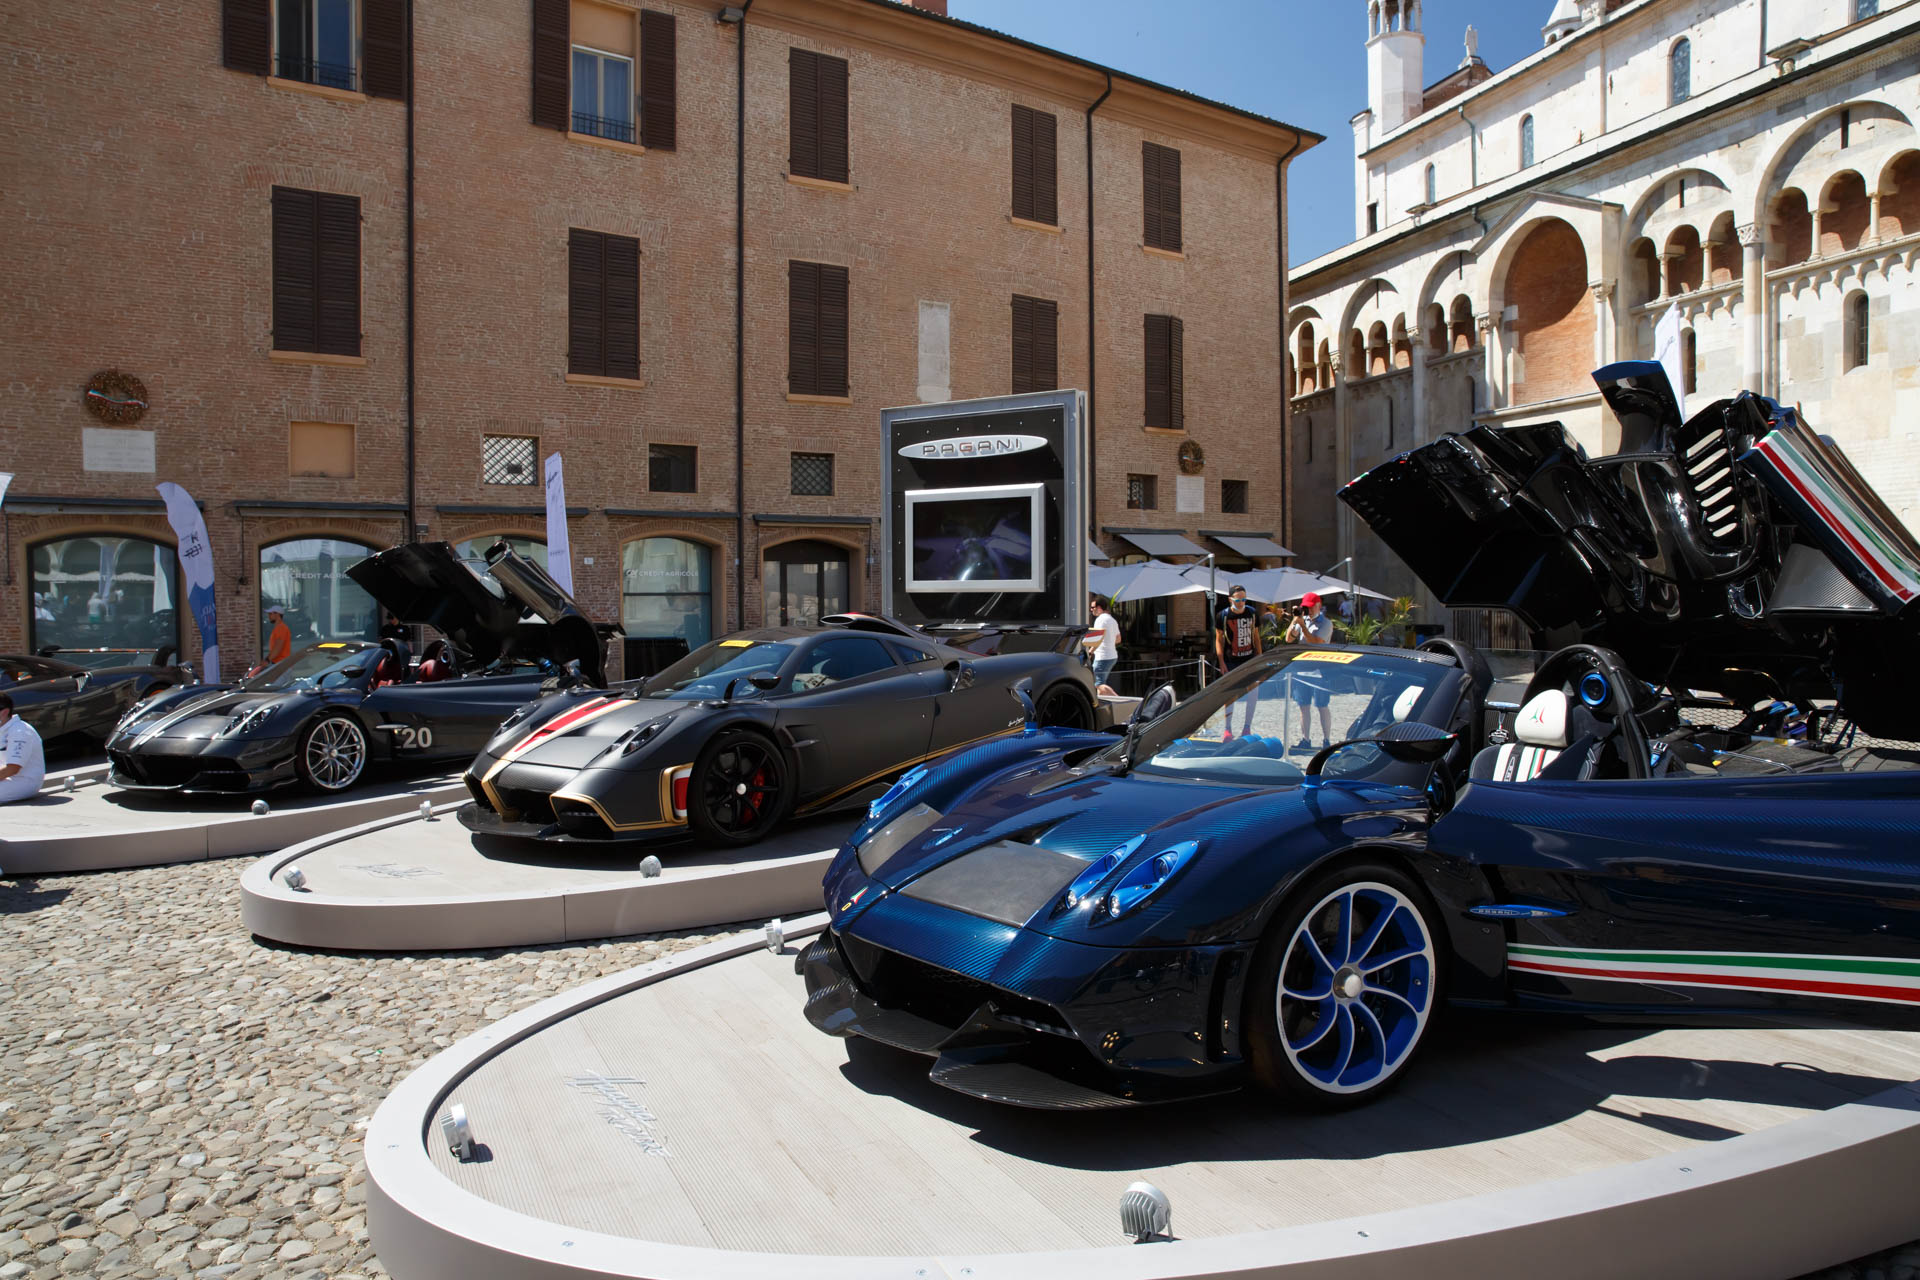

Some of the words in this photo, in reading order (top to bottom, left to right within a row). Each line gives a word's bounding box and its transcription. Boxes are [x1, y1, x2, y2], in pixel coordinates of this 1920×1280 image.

[922, 438, 1020, 455] PAGANI
[1237, 618, 1253, 628] ICH
[1237, 628, 1252, 638] BIN
[1238, 637, 1252, 647] EIN
[402, 727, 432, 748] 20
